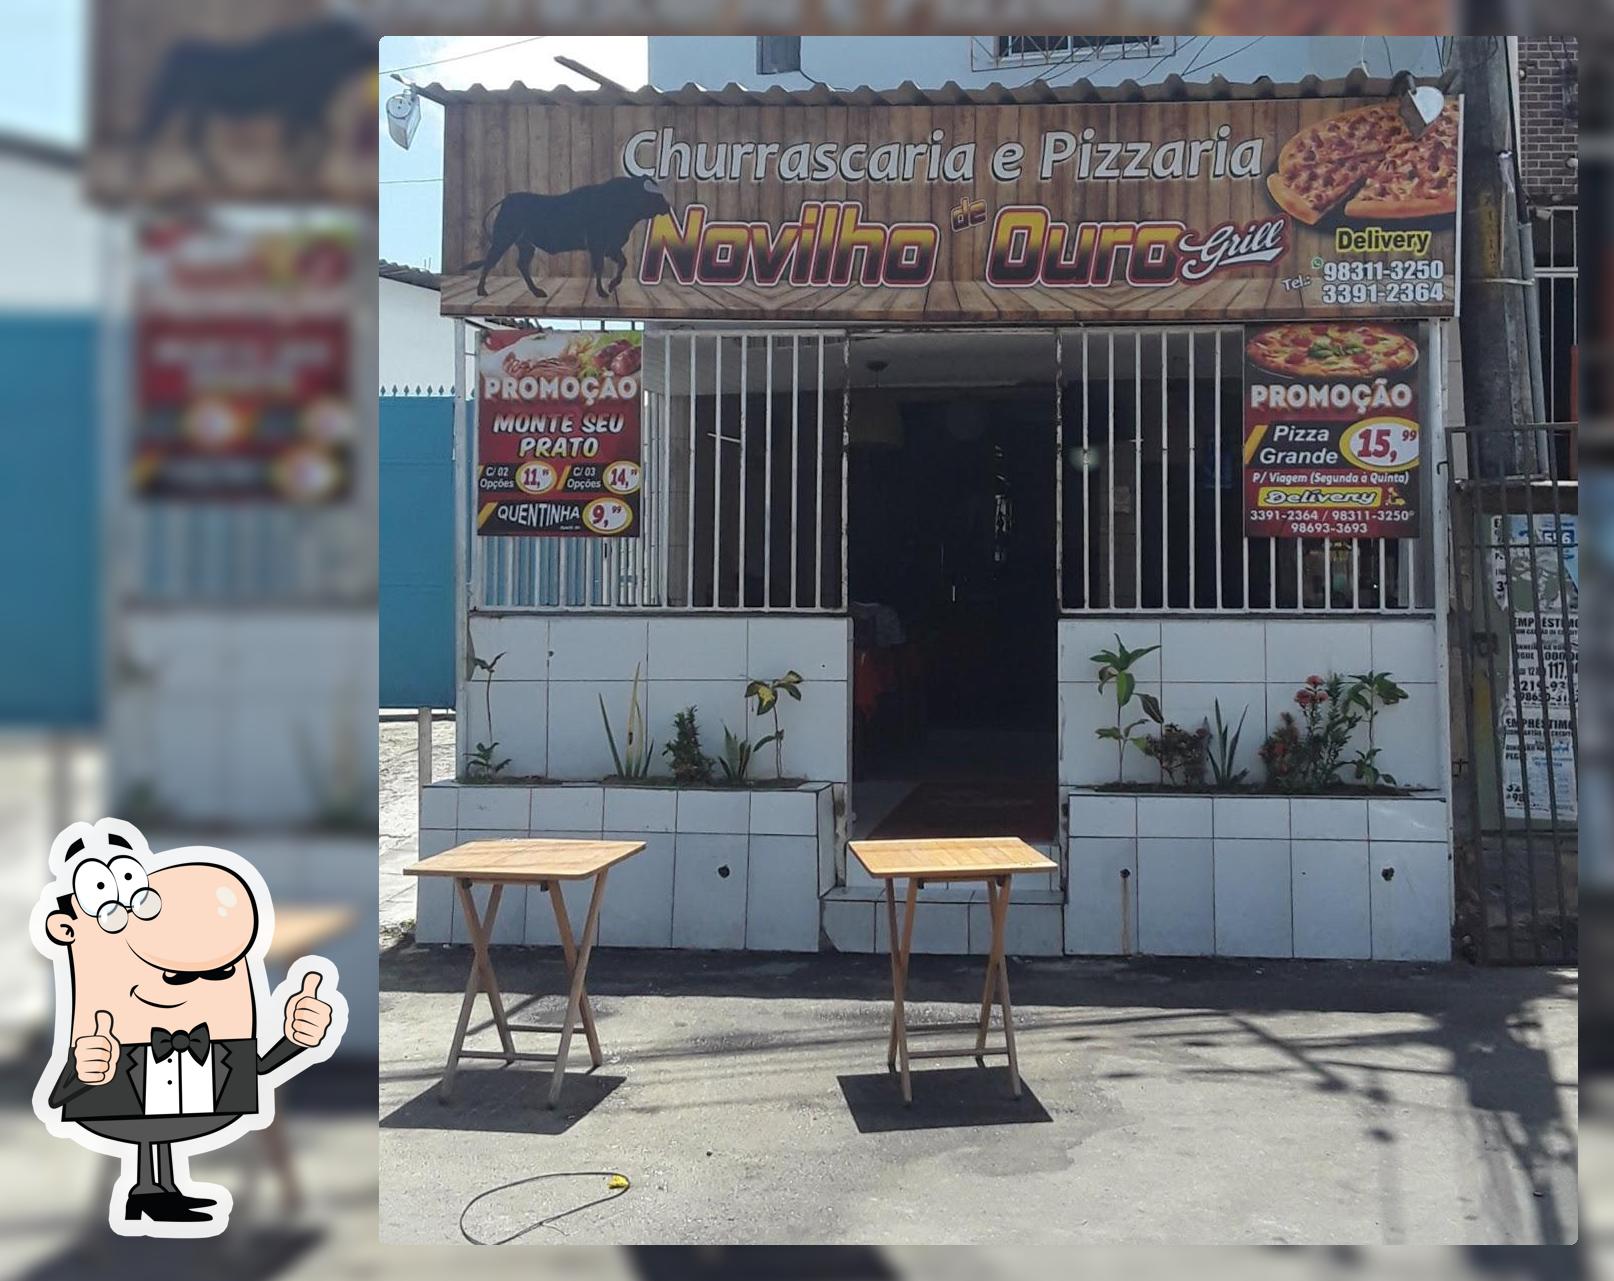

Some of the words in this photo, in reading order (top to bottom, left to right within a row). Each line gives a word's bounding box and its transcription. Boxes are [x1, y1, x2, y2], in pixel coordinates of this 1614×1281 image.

[623, 127, 975, 182] Churrascaria
[993, 142, 1025, 180] e
[1040, 125, 1264, 183] Pizzaria
[639, 201, 940, 288] Novilho
[950, 197, 987, 232] de
[985, 205, 1187, 288] Ouro
[1180, 218, 1289, 281] Grill
[1335, 227, 1432, 256] Delivery
[1323, 260, 1445, 282] 98311-3250
[1322, 282, 1445, 304] 3391-2364
[484, 371, 638, 405] PROMOÇÃO
[1251, 378, 1413, 414] PROMOÇÃO
[494, 415, 574, 433] MONTE
[581, 415, 625, 433] SEU
[1273, 425, 1330, 442] Pizza
[519, 437, 599, 458] PRATO
[1260, 448, 1339, 465] Grande
[1269, 473, 1308, 484] Viagem
[1310, 472, 1359, 484] (Segunda
[1370, 472, 1409, 484] Quinta)
[1265, 488, 1377, 505] Delivery
[498, 502, 580, 527] QUENTINHA
[1250, 510, 1318, 521] 3391-2364
[1331, 510, 1409, 521] 98311-3250
[1290, 523, 1368, 534] 98693-3693
